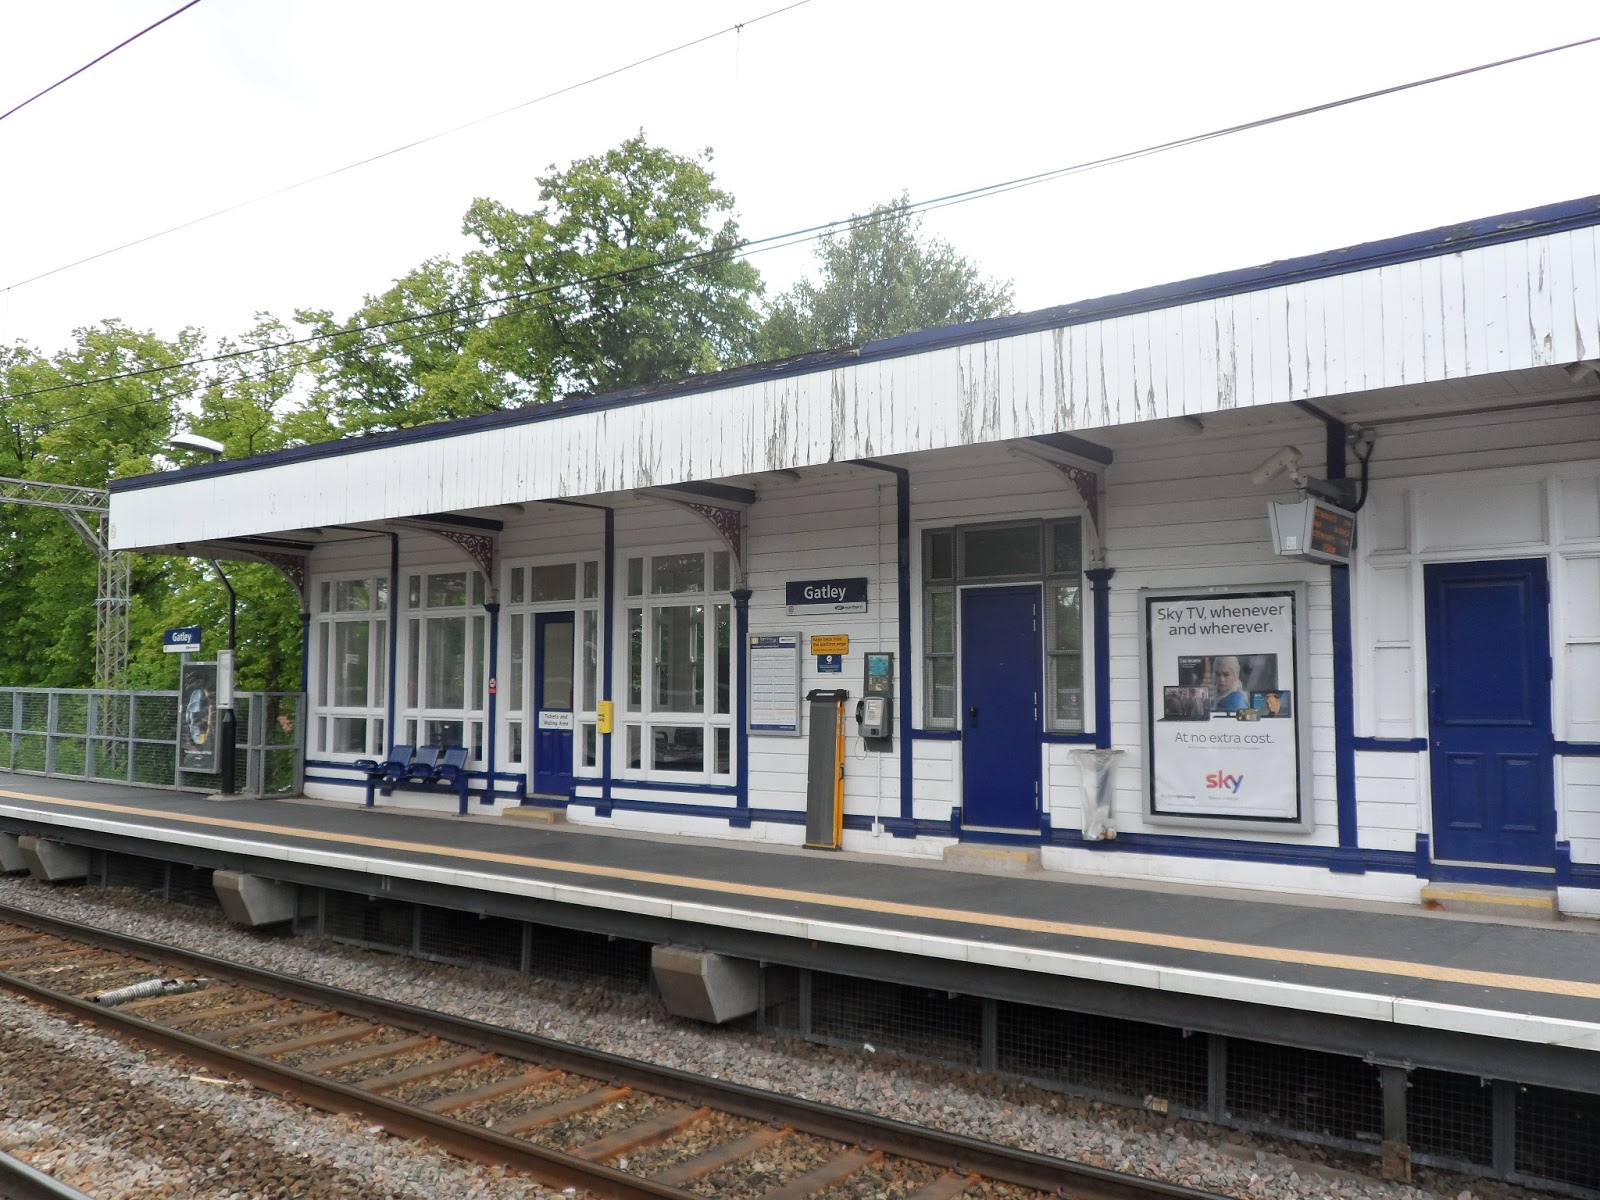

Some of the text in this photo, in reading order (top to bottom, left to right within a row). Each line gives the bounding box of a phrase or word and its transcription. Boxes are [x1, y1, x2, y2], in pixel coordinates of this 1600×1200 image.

[804, 584, 846, 602] Gatley
[1157, 605, 1285, 623] Sky TV, whenever
[1169, 621, 1273, 636] and wherever.
[172, 632, 192, 644] Gatley
[1174, 732, 1275, 744] At no extra cost.
[1206, 770, 1244, 794] sky
